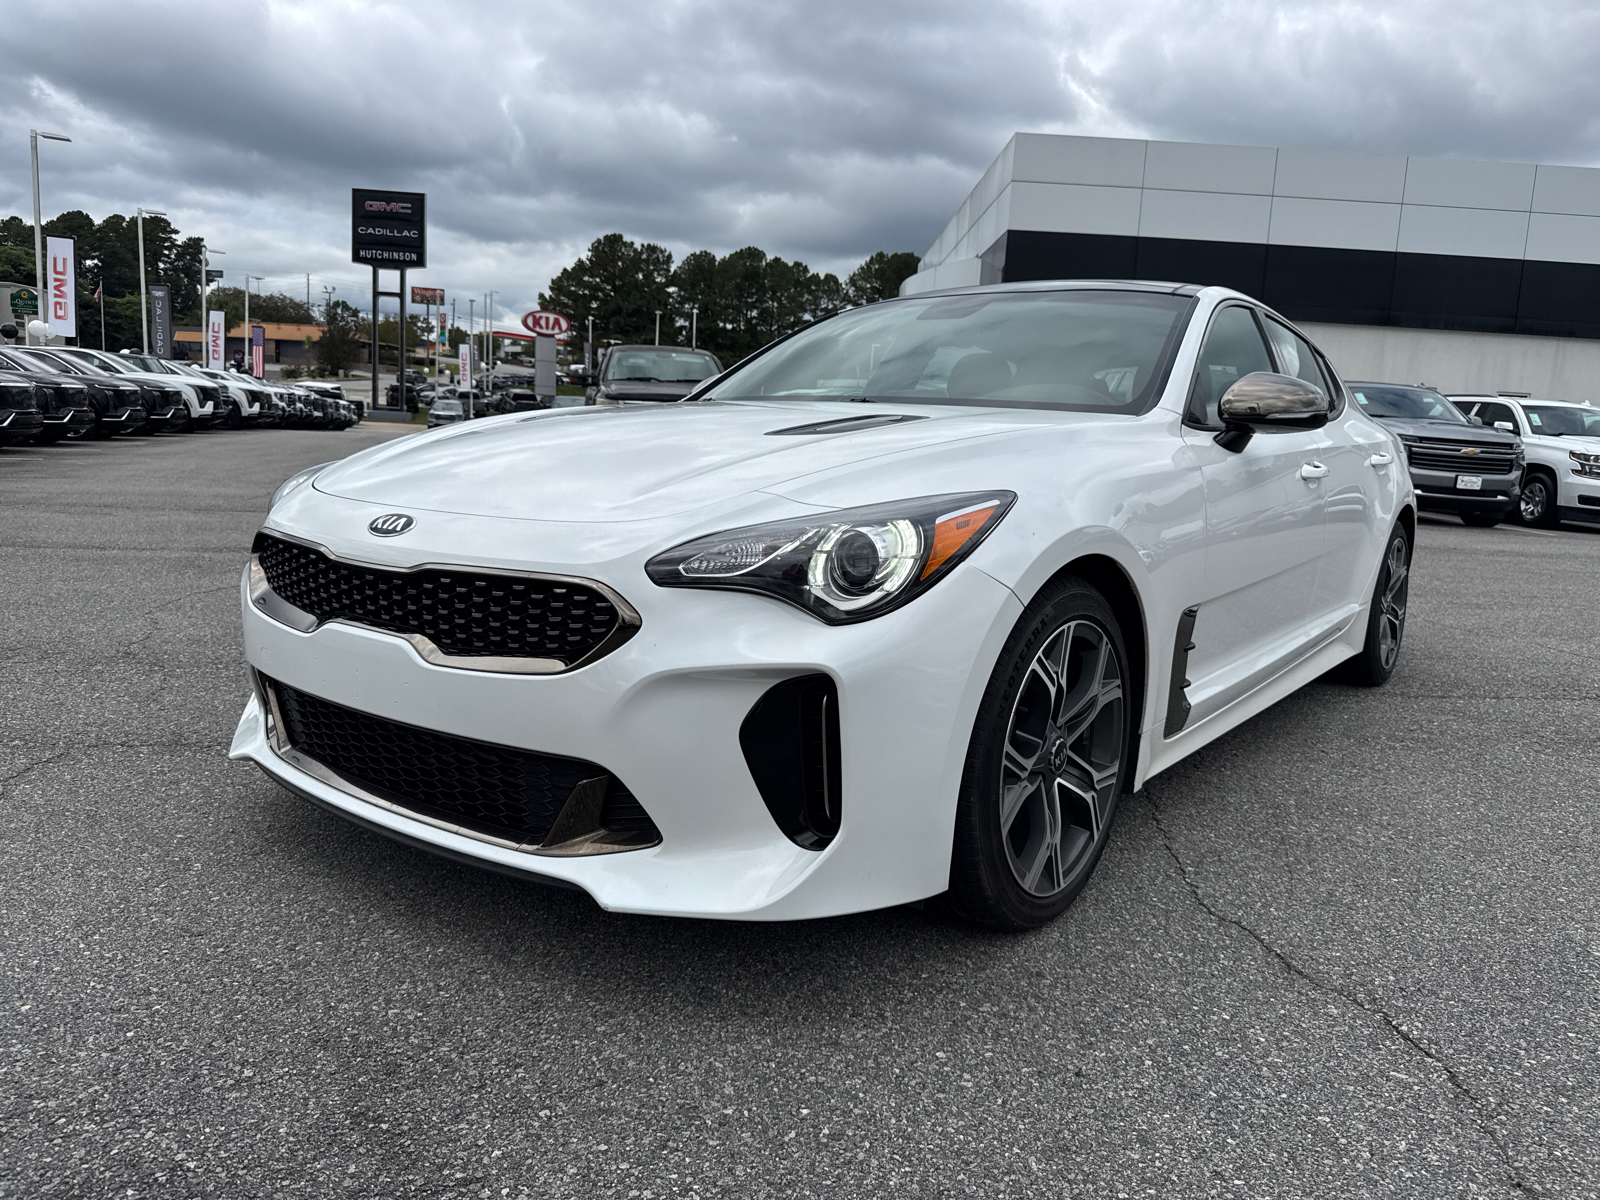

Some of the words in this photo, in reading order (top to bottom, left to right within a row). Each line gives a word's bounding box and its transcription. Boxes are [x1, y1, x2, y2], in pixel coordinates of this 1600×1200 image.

[365, 201, 412, 213] GMC
[358, 227, 419, 238] CADILLAC
[360, 250, 418, 261] HUTCHINSON
[53, 256, 68, 320] GMC
[155, 300, 164, 355] CADILLAC
[531, 314, 564, 332] KIA
[211, 322, 221, 361] GMC
[372, 515, 408, 531] KIA
[997, 617, 1049, 719] NEOTERRA
